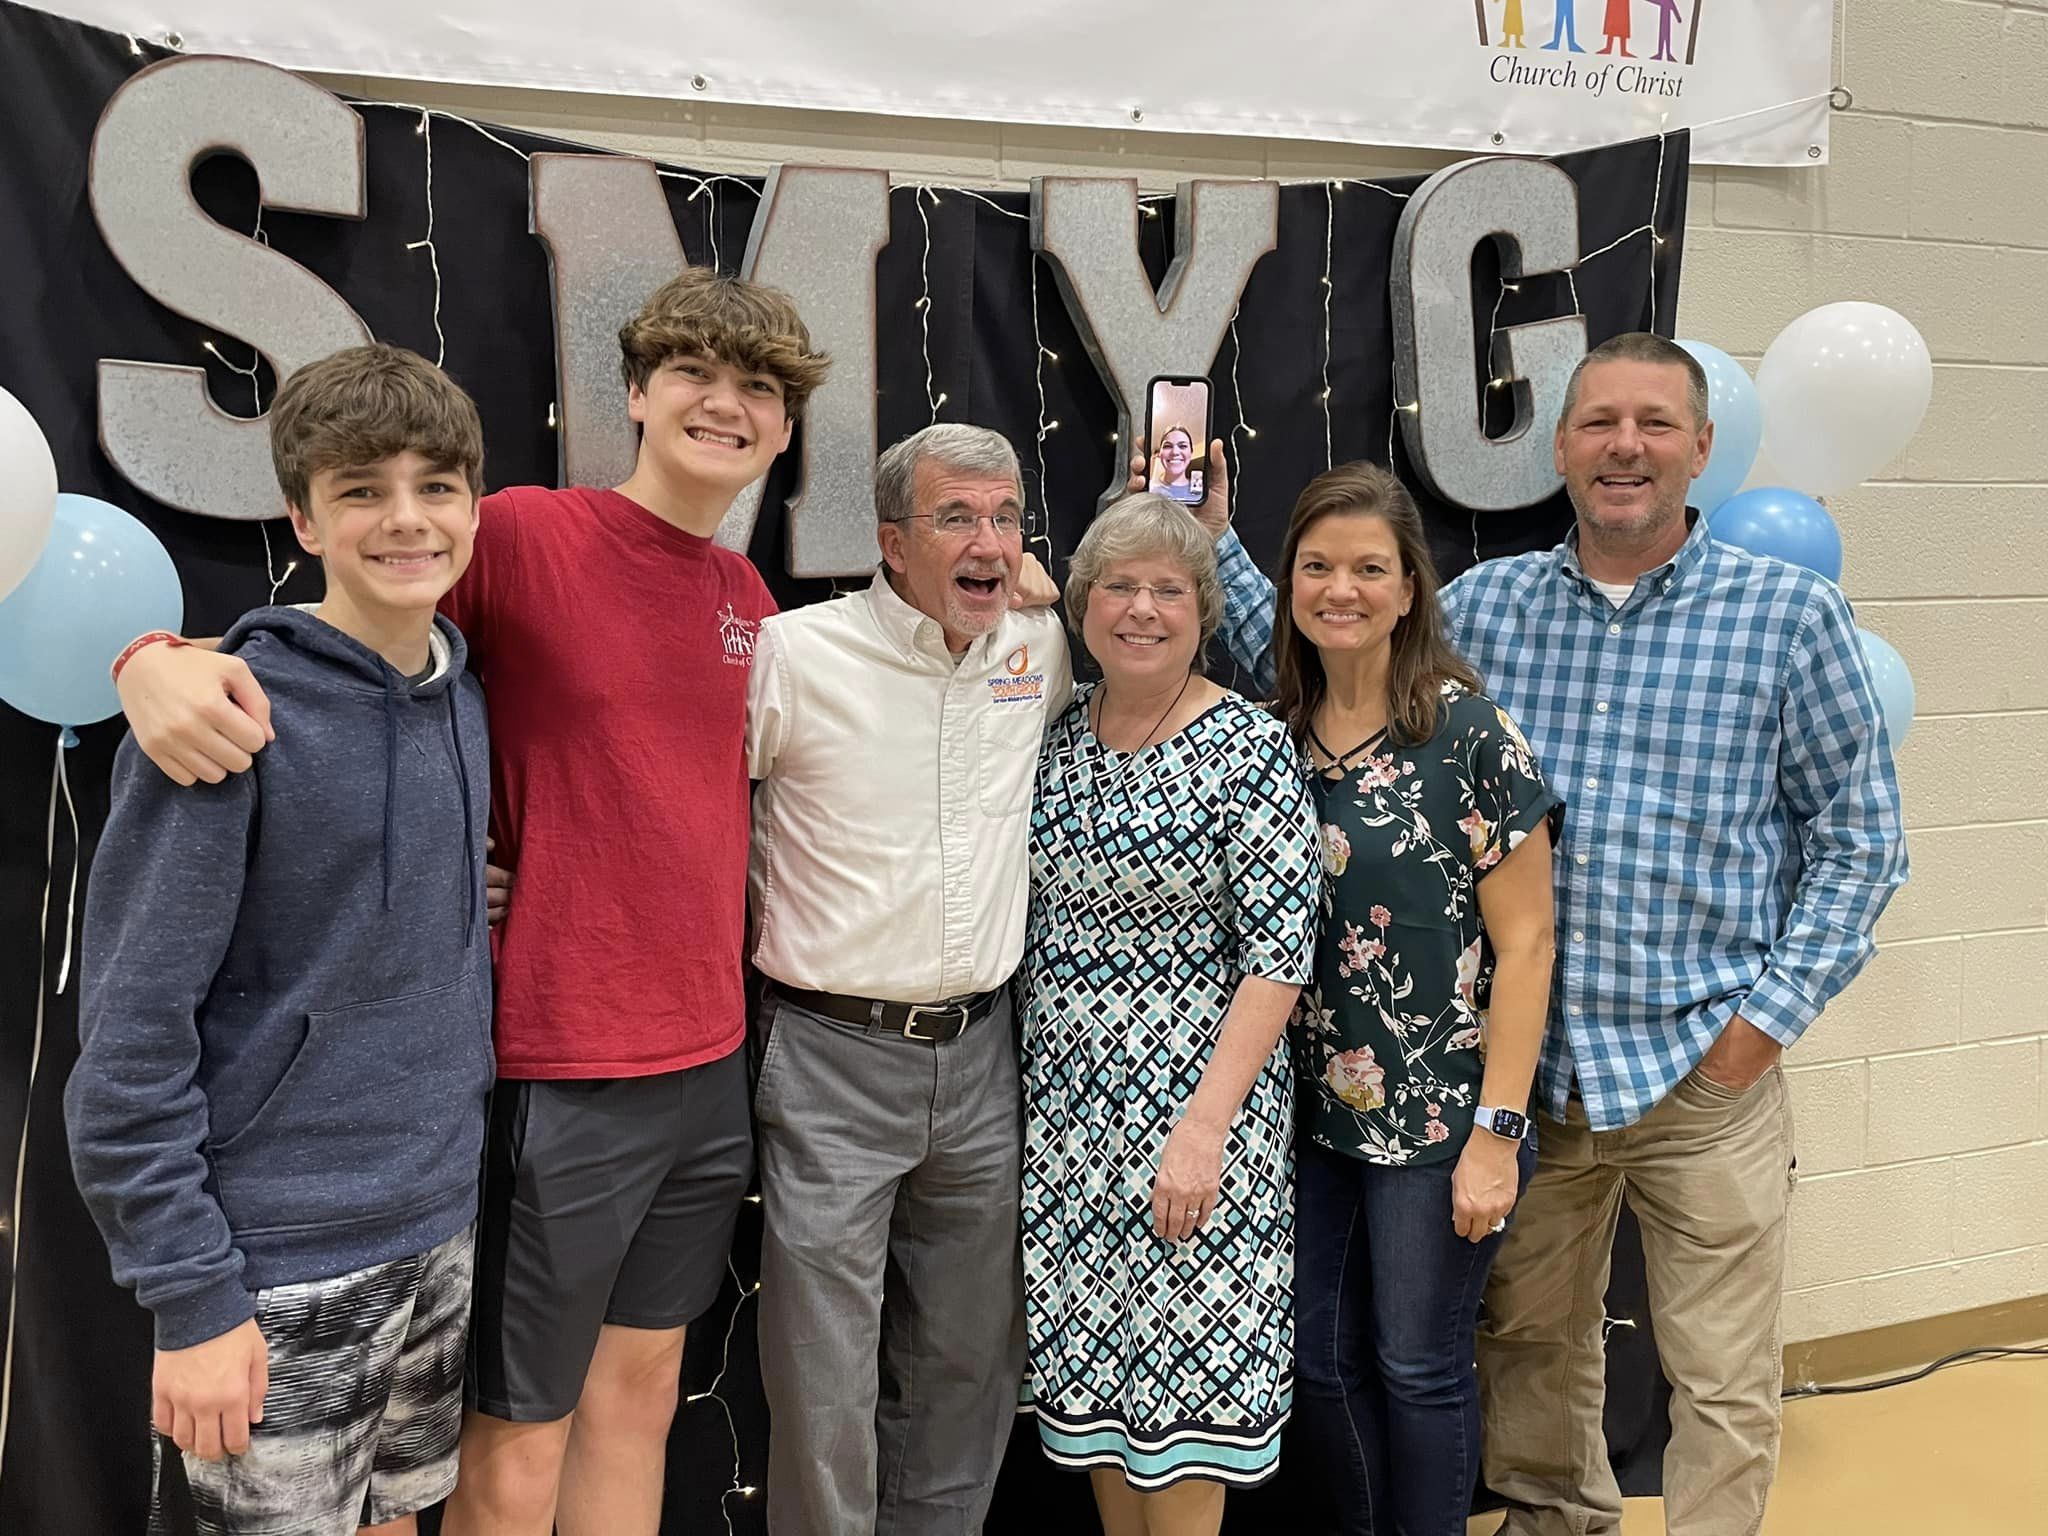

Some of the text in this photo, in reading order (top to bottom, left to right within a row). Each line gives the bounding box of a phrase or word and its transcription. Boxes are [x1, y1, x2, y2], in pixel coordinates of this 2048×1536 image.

[1490, 54, 1684, 98] Church of Christ
